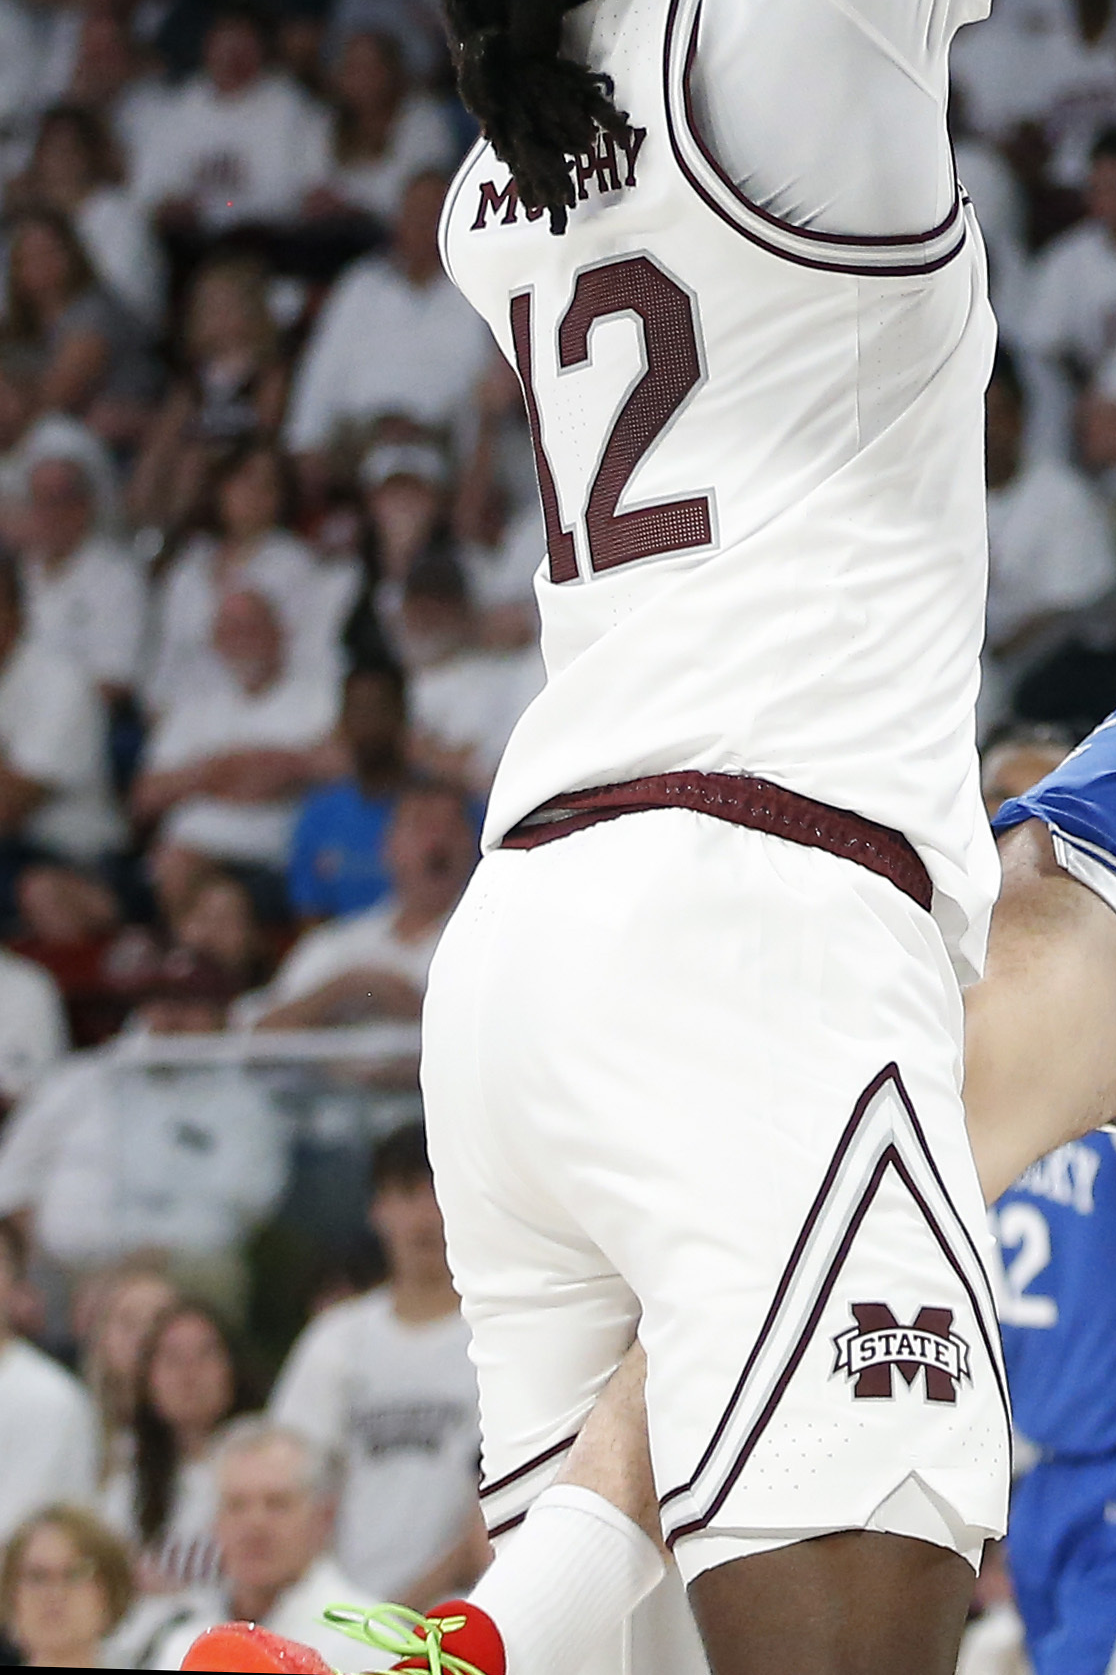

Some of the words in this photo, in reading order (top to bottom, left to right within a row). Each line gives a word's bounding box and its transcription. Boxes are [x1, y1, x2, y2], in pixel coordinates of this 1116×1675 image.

[470, 127, 647, 231] MPHY
[509, 251, 720, 584] 12
[859, 1333, 951, 1368] STATE
